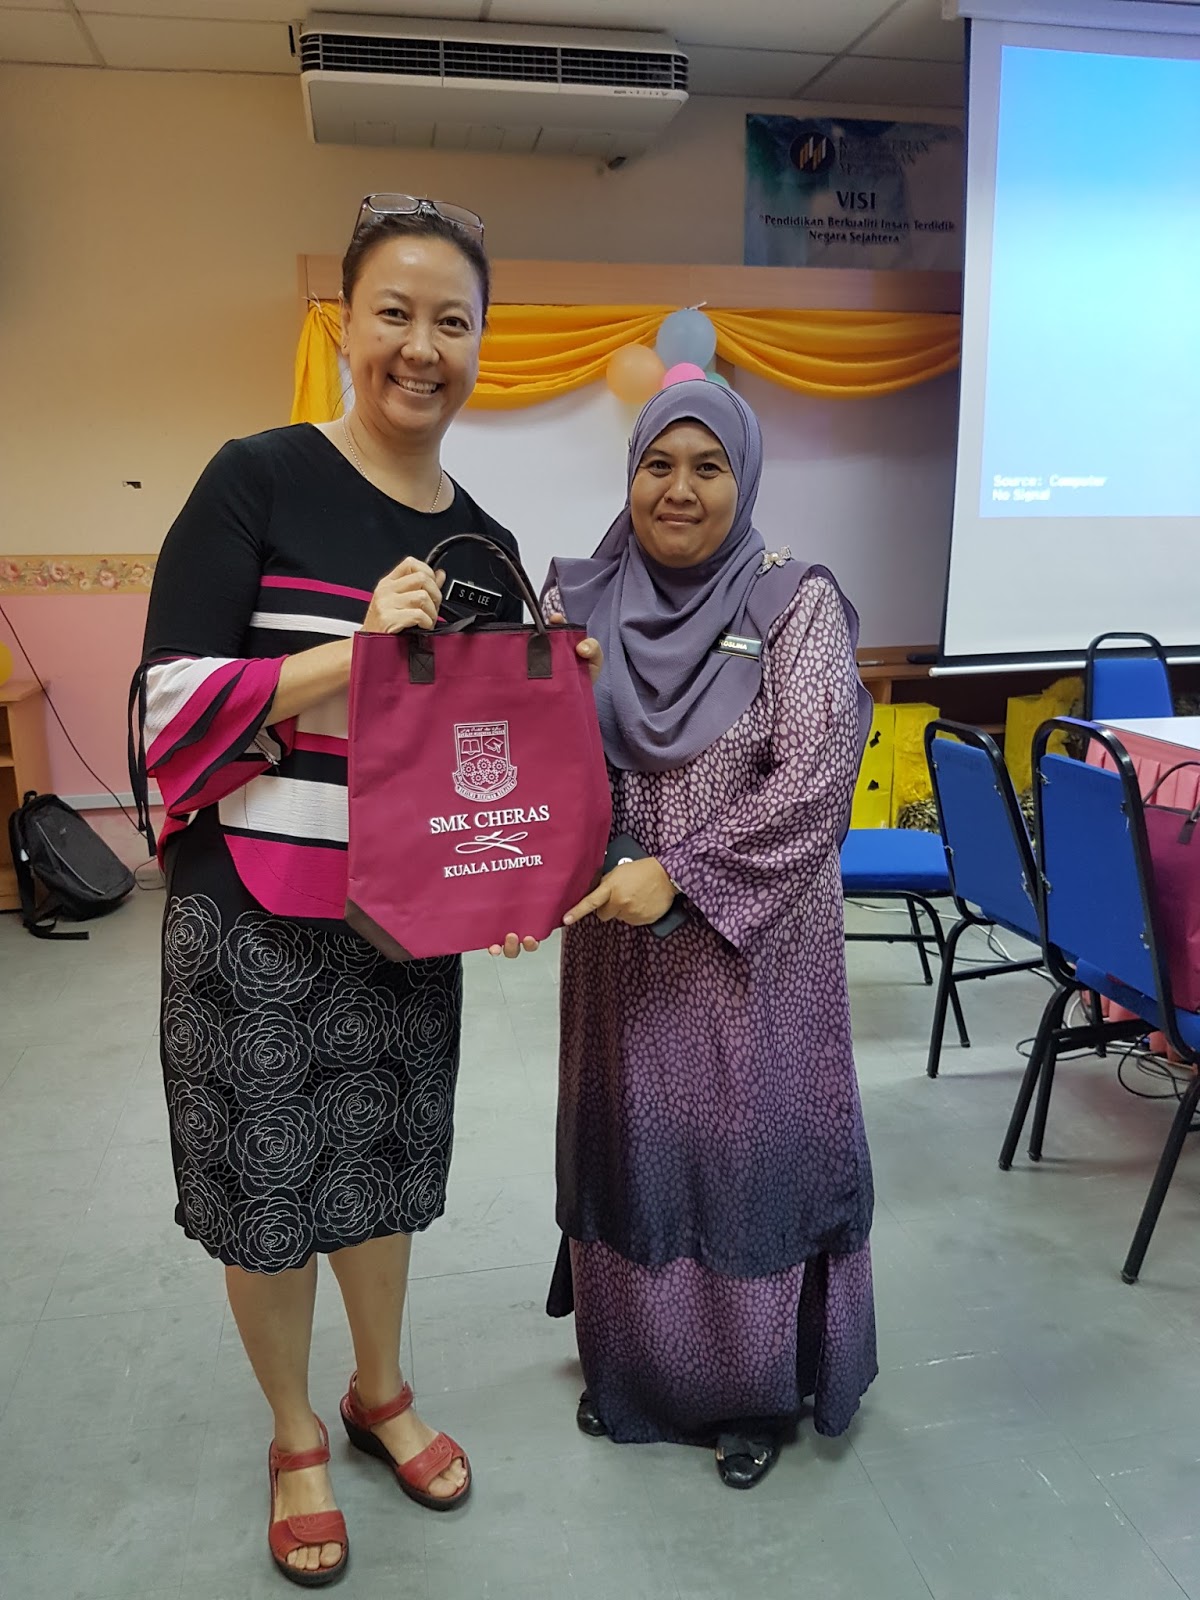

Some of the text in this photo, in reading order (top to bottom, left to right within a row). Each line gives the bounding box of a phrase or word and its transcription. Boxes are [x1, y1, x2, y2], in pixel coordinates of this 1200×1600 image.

[836, 190, 877, 211] VISI
[809, 230, 848, 246] Negara
[459, 589, 490, 606] S C LEE
[429, 804, 550, 834] SMK CHERAS
[443, 854, 543, 879] KUALA LUMPUR
